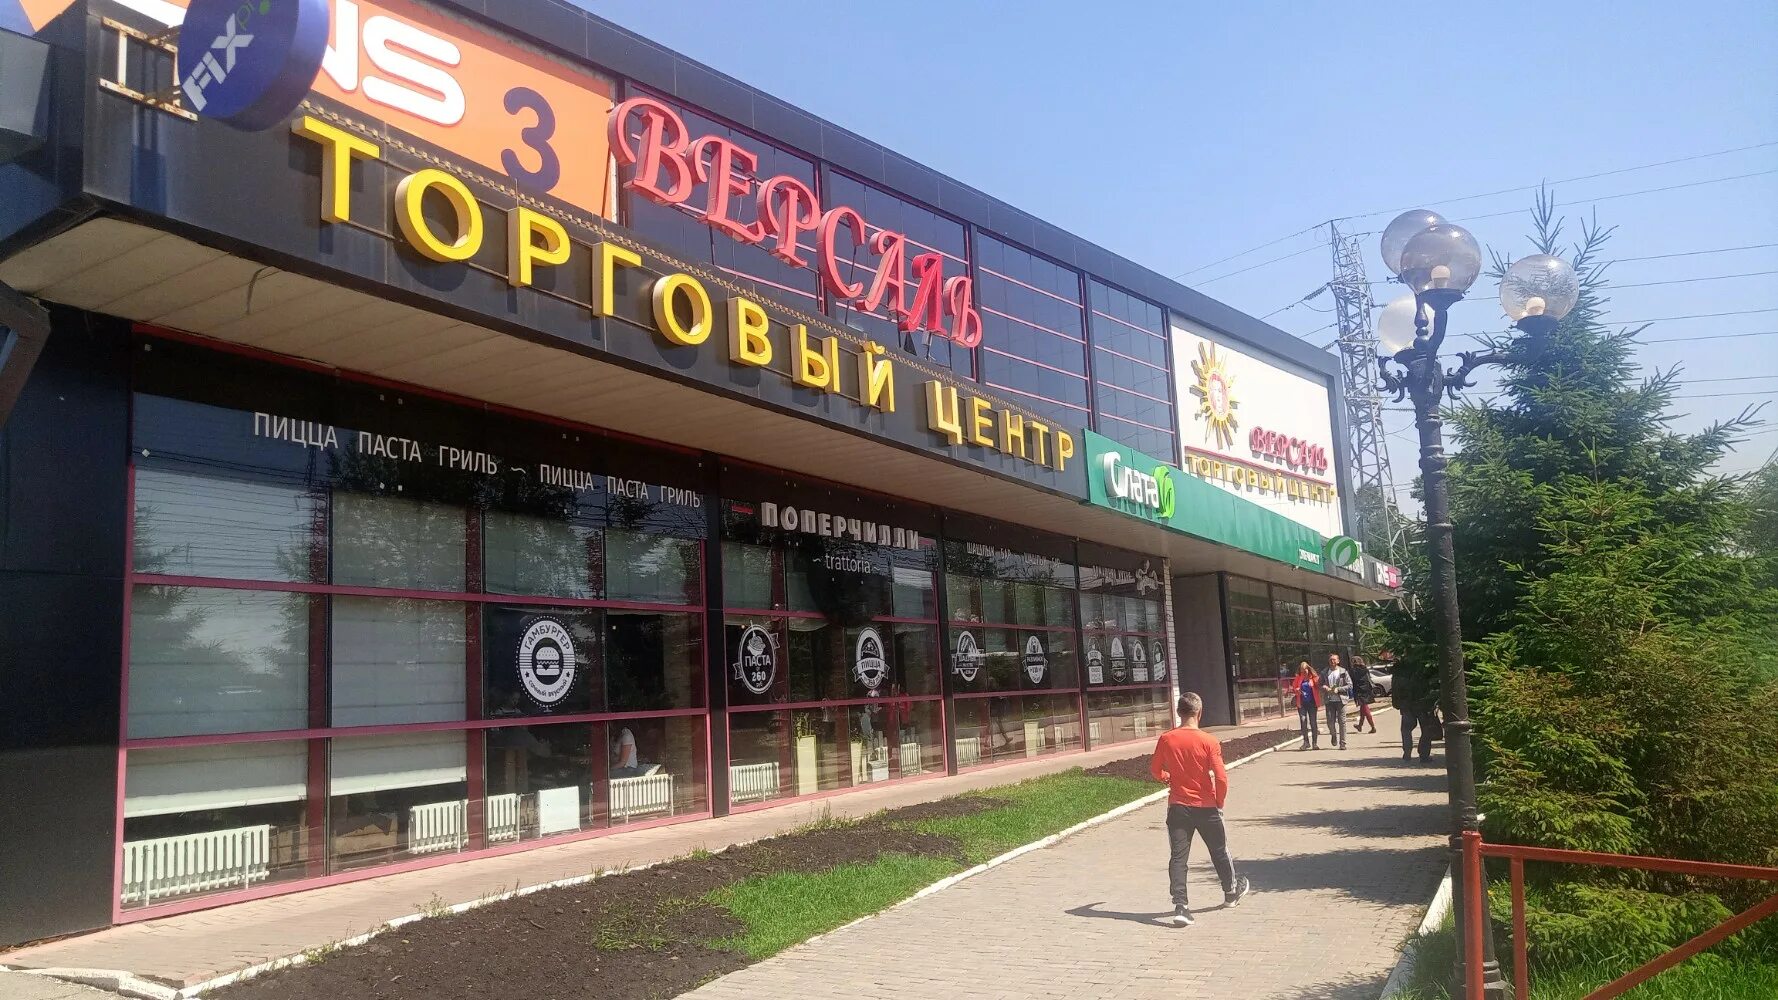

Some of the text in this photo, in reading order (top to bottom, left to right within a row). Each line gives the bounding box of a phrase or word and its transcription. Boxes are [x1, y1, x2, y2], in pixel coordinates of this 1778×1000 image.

[182, 13, 255, 112] FIX
[501, 87, 560, 191] 3
[608, 97, 983, 348] ВЕРСАЛЬ
[292, 115, 1074, 471] ТОРГОВЫЙ ЦЕНТР
[254, 412, 700, 508] ПИЦЦА ПАСТА ГРИЛЬ ПИЦЦА ПАСТА ГРИЛЬ
[1250, 426, 1328, 471] ВЕРСАЛЬ
[1104, 451, 1160, 509] Слата
[1185, 454, 1338, 504] ТОРГОВЫЙ ЦЕНТР
[761, 501, 919, 550] ПОПЕРЧИЛЛИ
[825, 553, 871, 574] trattoria
[524, 624, 570, 650] ГАМБУРГЕР
[745, 654, 772, 667] ПАСТА
[751, 671, 767, 682] 260
